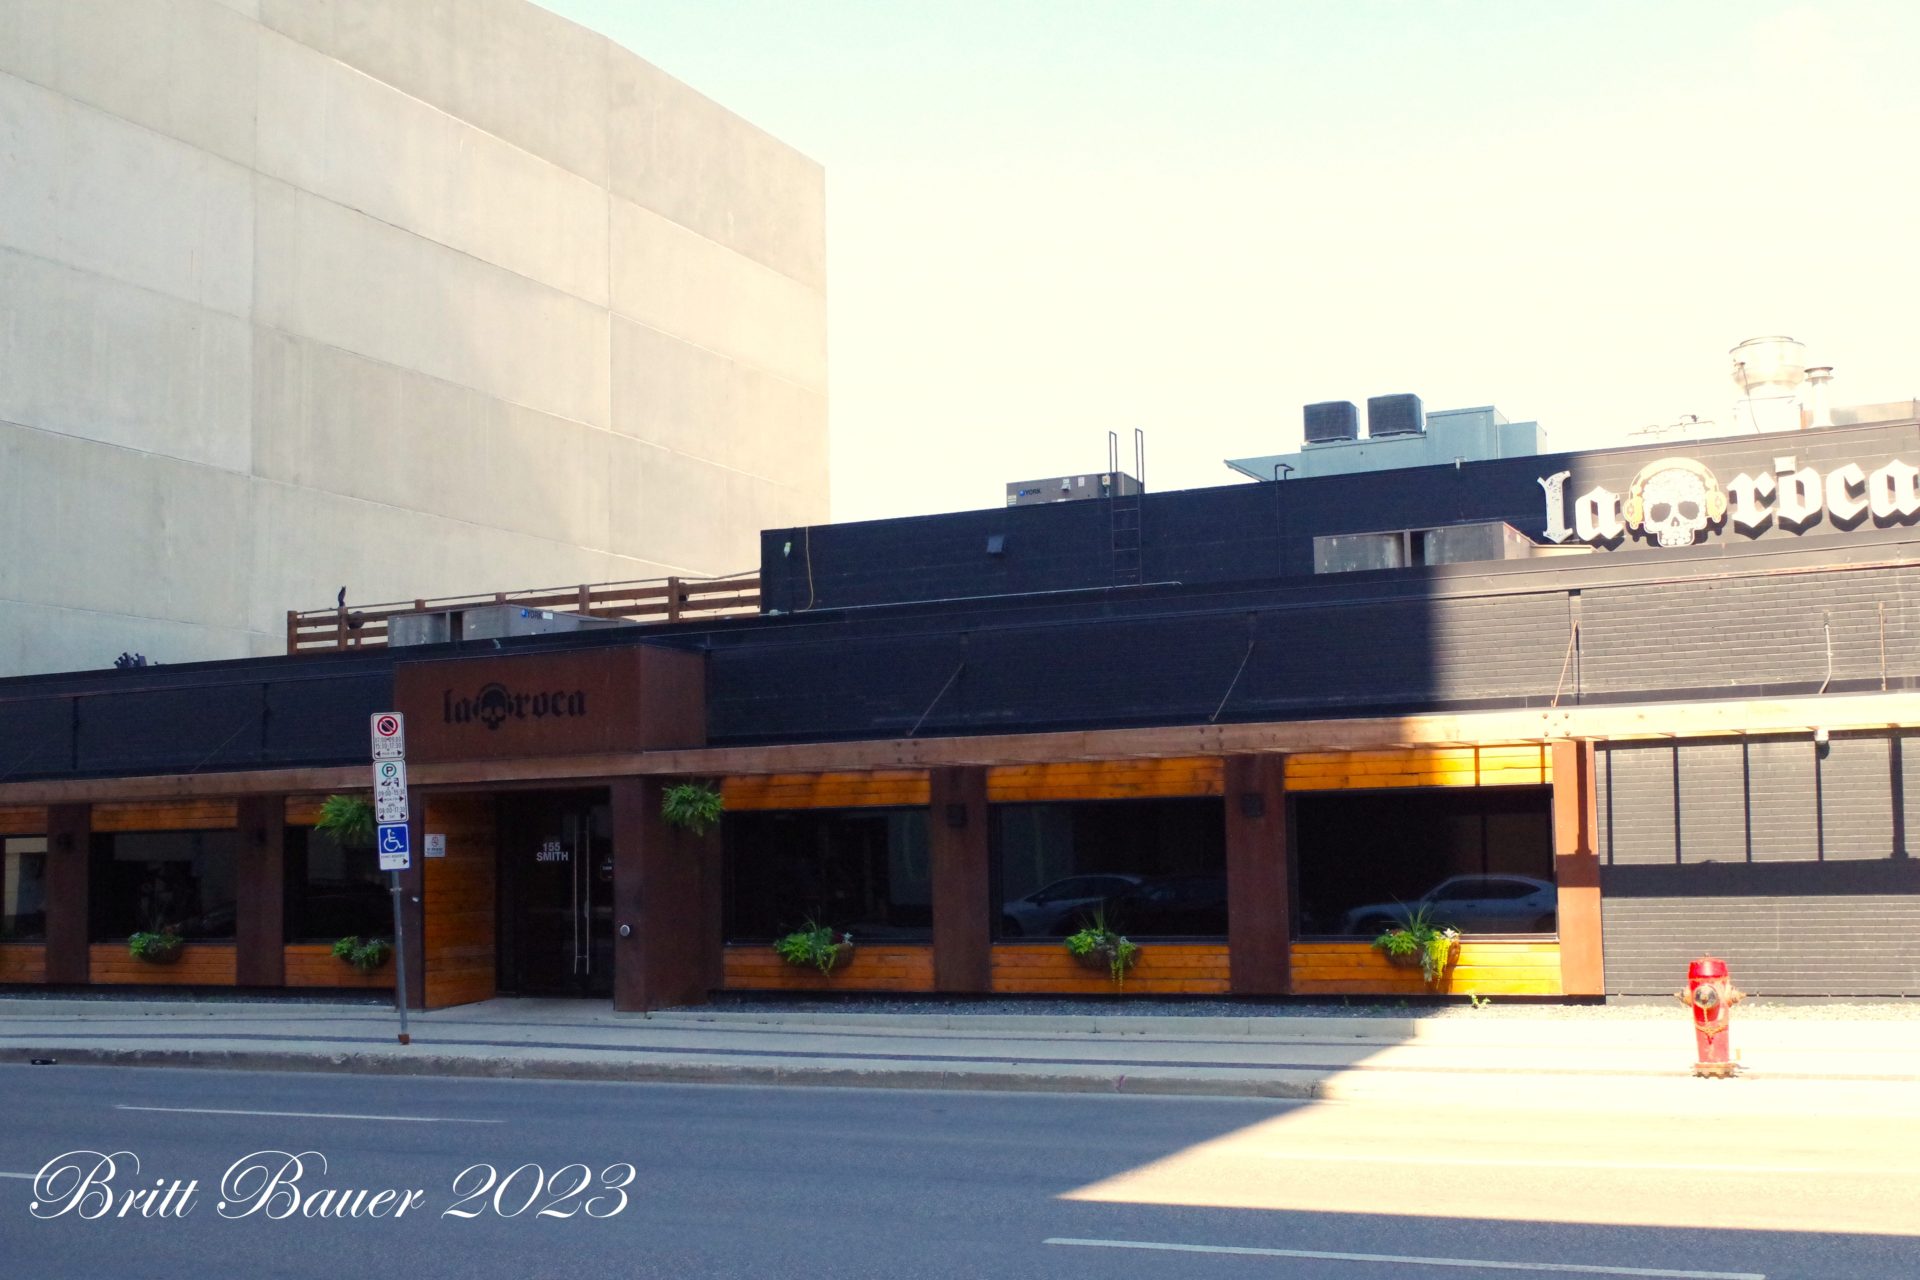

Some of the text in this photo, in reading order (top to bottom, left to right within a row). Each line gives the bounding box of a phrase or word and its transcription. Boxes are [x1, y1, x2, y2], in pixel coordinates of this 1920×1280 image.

[1024, 488, 1041, 496] YORK
[1727, 459, 1920, 529] roca
[513, 689, 587, 720] roca
[386, 766, 393, 775] P
[542, 841, 561, 852] 155
[536, 851, 569, 862] SMITH
